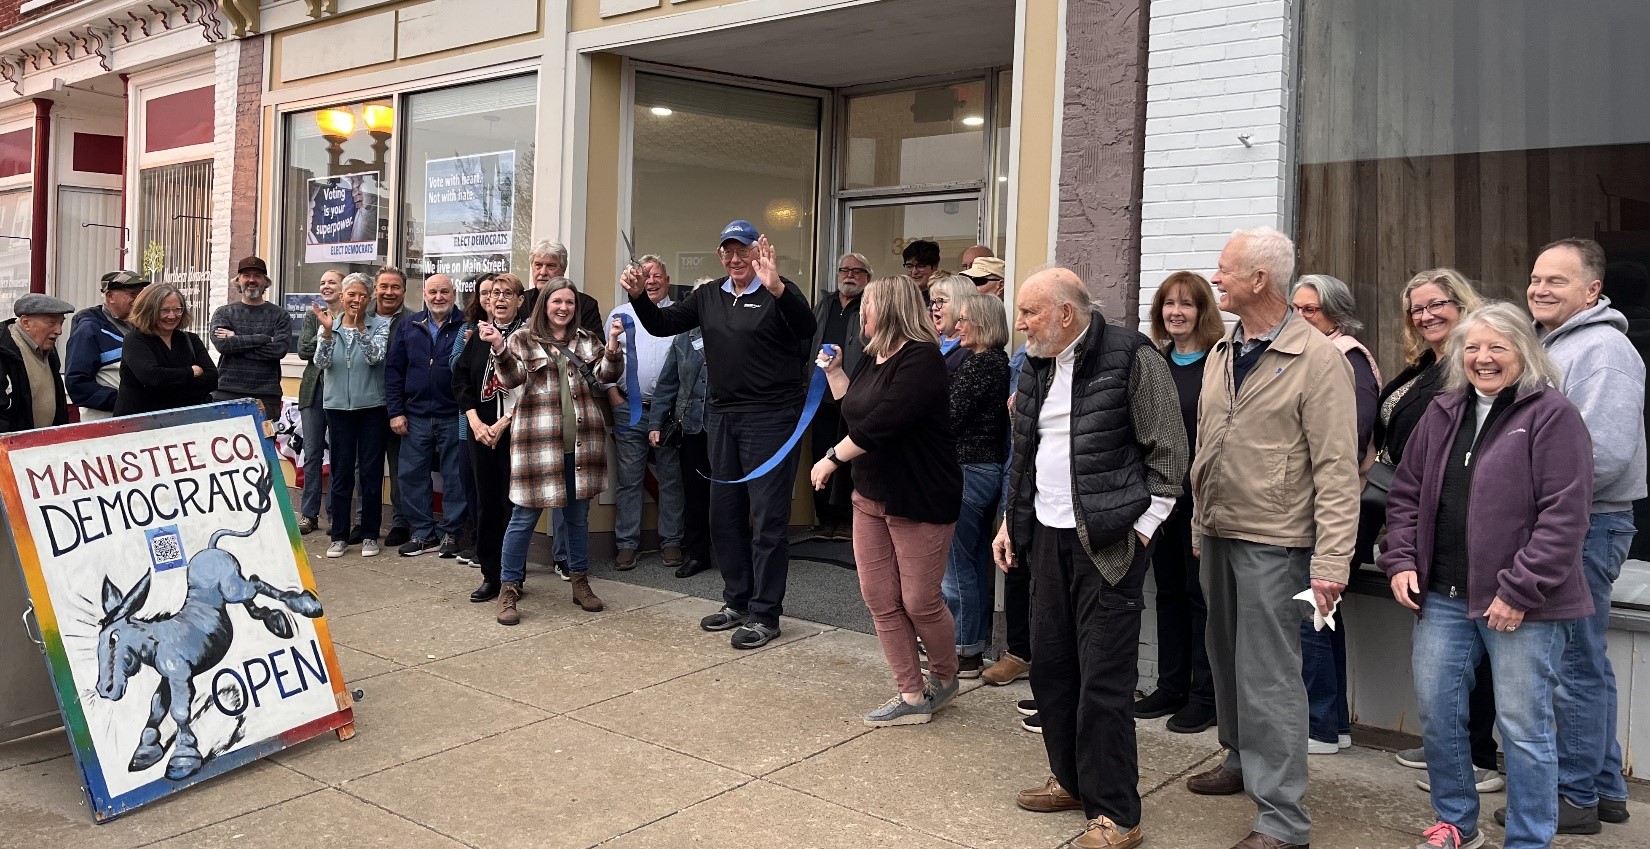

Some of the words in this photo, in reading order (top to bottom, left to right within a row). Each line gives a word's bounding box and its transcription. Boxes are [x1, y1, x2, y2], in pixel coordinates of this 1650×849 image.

[429, 176, 444, 188] Vote
[445, 173, 460, 187] with
[461, 172, 482, 185] heart.
[323, 186, 346, 201] Voting
[428, 191, 440, 203] Not
[441, 189, 457, 202] with
[323, 204, 330, 217] is
[330, 204, 346, 220] your
[316, 216, 354, 239] superpower.
[453, 235, 470, 247] ELECT
[471, 233, 508, 246] DEMOCRATS
[330, 245, 344, 256] ELECT
[344, 243, 374, 255] DEMOCRATS
[424, 260, 436, 275] We
[436, 260, 450, 274] live
[451, 262, 461, 274] on
[462, 258, 481, 273] Main
[482, 258, 508, 272] Street.
[454, 278, 477, 293] Street
[26, 441, 206, 500] MANISTEE
[211, 433, 259, 464] CO.
[39, 465, 272, 558] DEMOCRATS
[212, 640, 328, 716] OPEN
